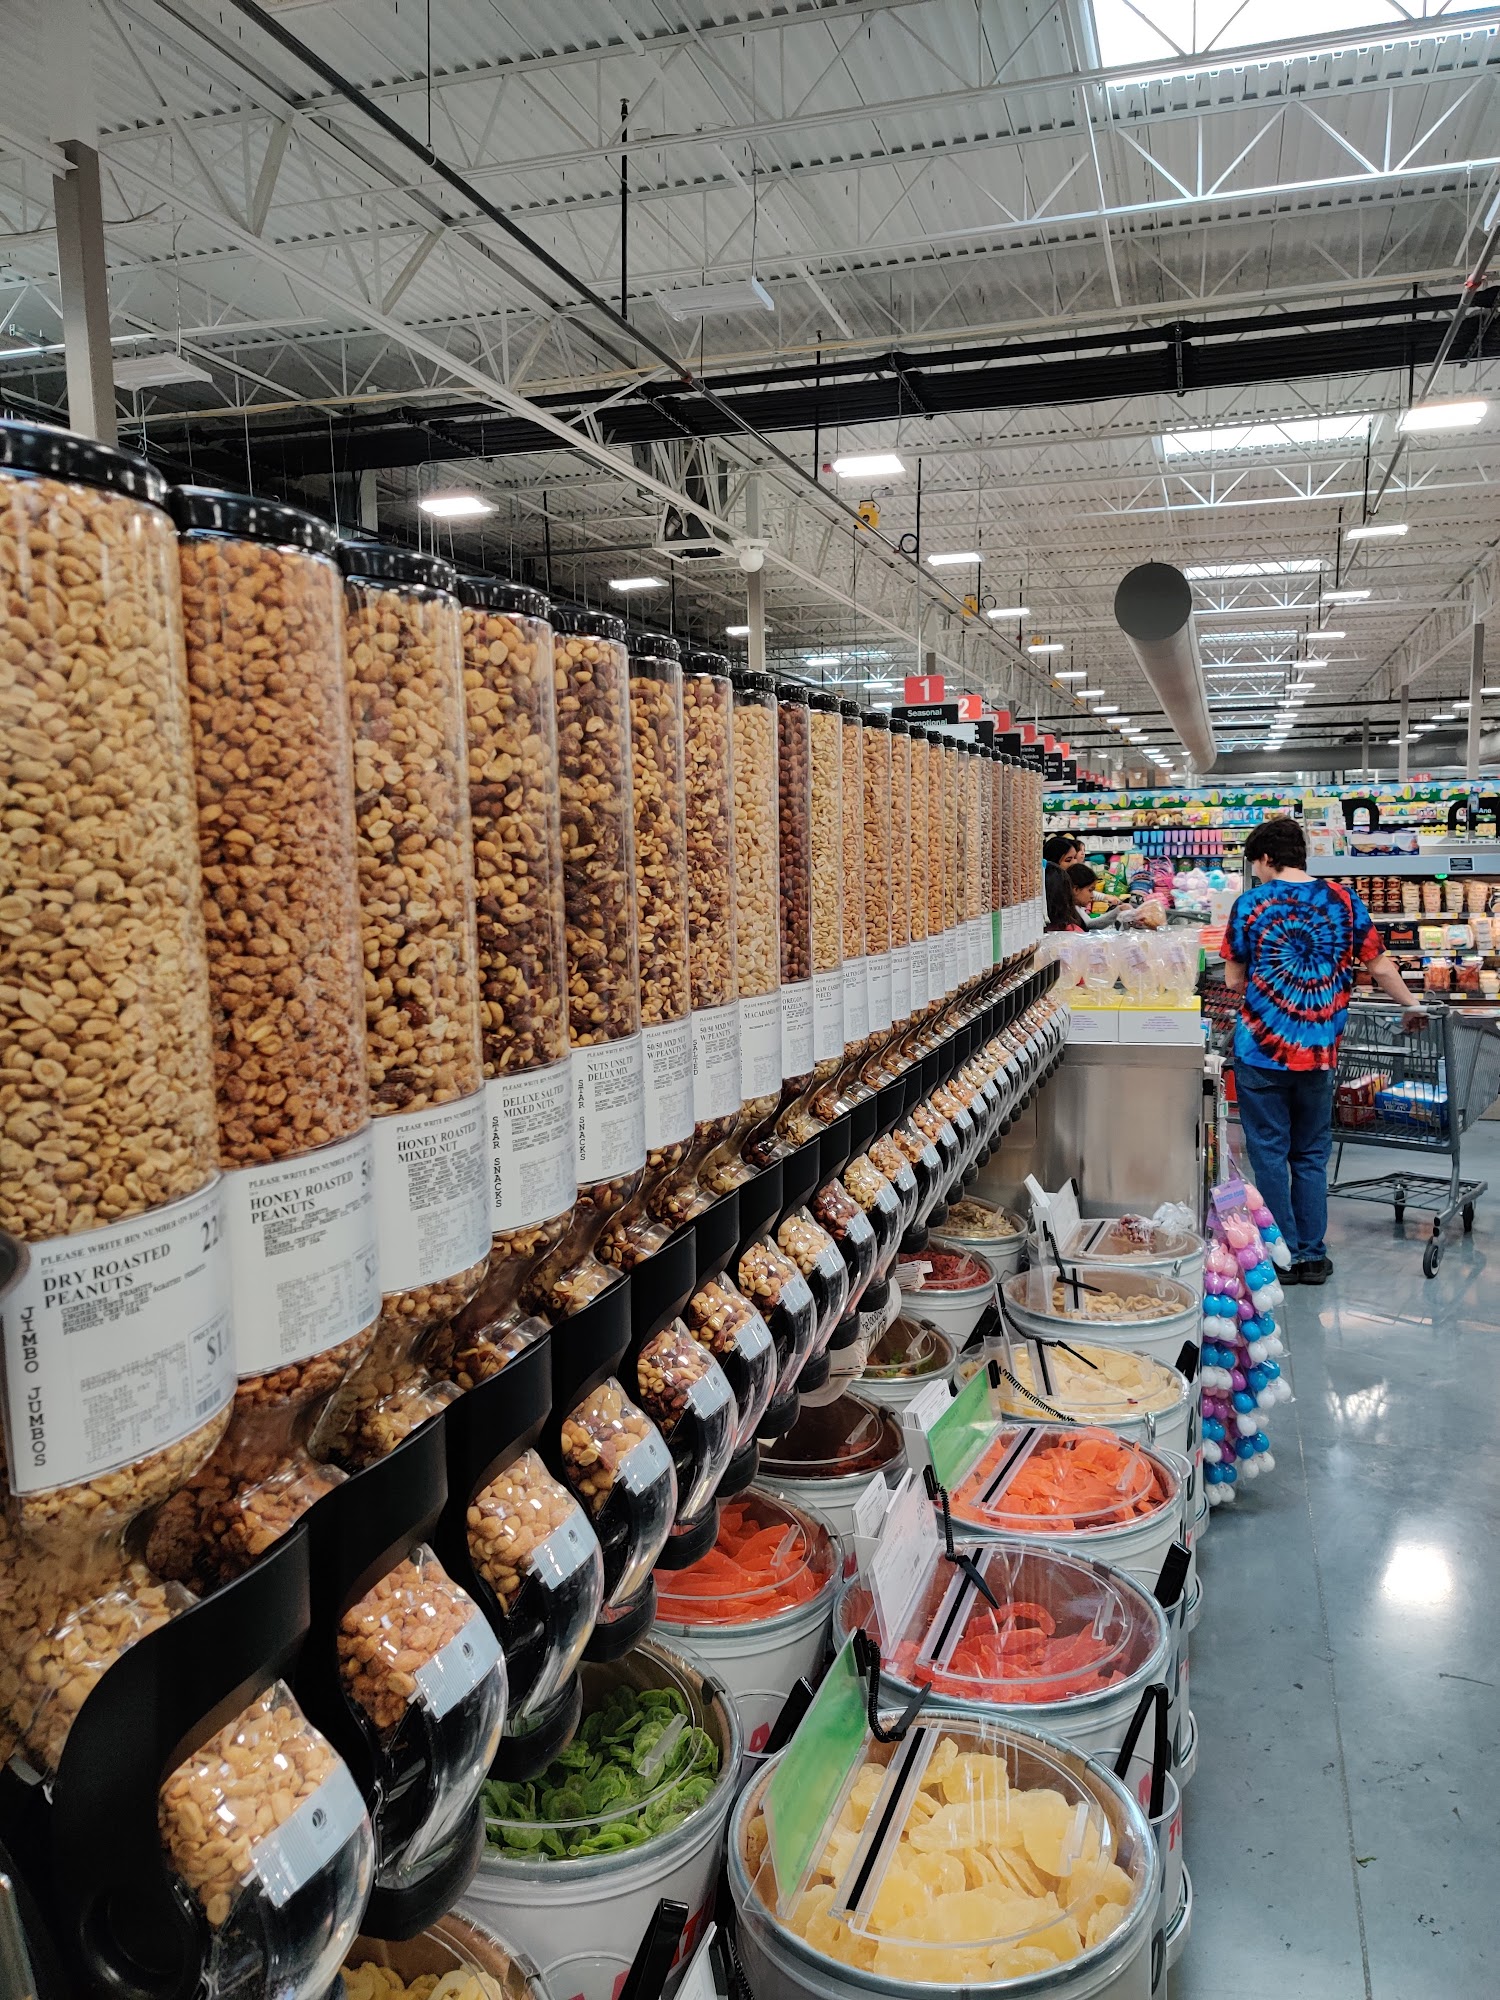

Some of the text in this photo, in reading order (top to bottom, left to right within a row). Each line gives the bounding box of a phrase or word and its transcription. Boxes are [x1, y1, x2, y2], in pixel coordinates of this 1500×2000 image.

[919, 679, 930, 701] 1
[907, 707, 943, 718] Seasonal
[958, 698, 969, 718] 2
[664, 1037, 677, 1048] MXD
[587, 1061, 609, 1073] NUTS
[588, 1066, 628, 1082] DELUX MIX
[502, 1083, 522, 1091] PLEASE
[503, 1084, 564, 1108] DELUXE SALTED
[503, 1099, 555, 1118] MIXED NUTS
[396, 1123, 422, 1133] PLEASE
[424, 1118, 442, 1127] WRITE
[577, 1079, 586, 1161] STAR SNACKS
[398, 1121, 477, 1151] HONEY ROASTED
[398, 1141, 458, 1163] MIXED NUT
[492, 1116, 502, 1207] STAR SNACKS
[249, 1175, 280, 1189] PLEASE
[282, 1169, 307, 1180] WRITE
[309, 1165, 321, 1175] BIN
[250, 1188, 302, 1210] HONEY
[305, 1171, 354, 1197] ROASTED
[251, 1198, 316, 1224] PEANUTS
[40, 1248, 85, 1266] PLEASE
[87, 1238, 122, 1254] WRITE
[124, 1232, 141, 1245] BIN
[143, 1220, 177, 1239] NUMBER
[43, 1243, 170, 1292] DRY ROASTED
[44, 1273, 134, 1309] PEANUTS
[62, 1313, 98, 1329] KOSHER
[63, 1319, 104, 1335] PRODUCT
[110, 1313, 121, 1322] OF
[20, 1306, 47, 1467] JIMBO JUMBOS
